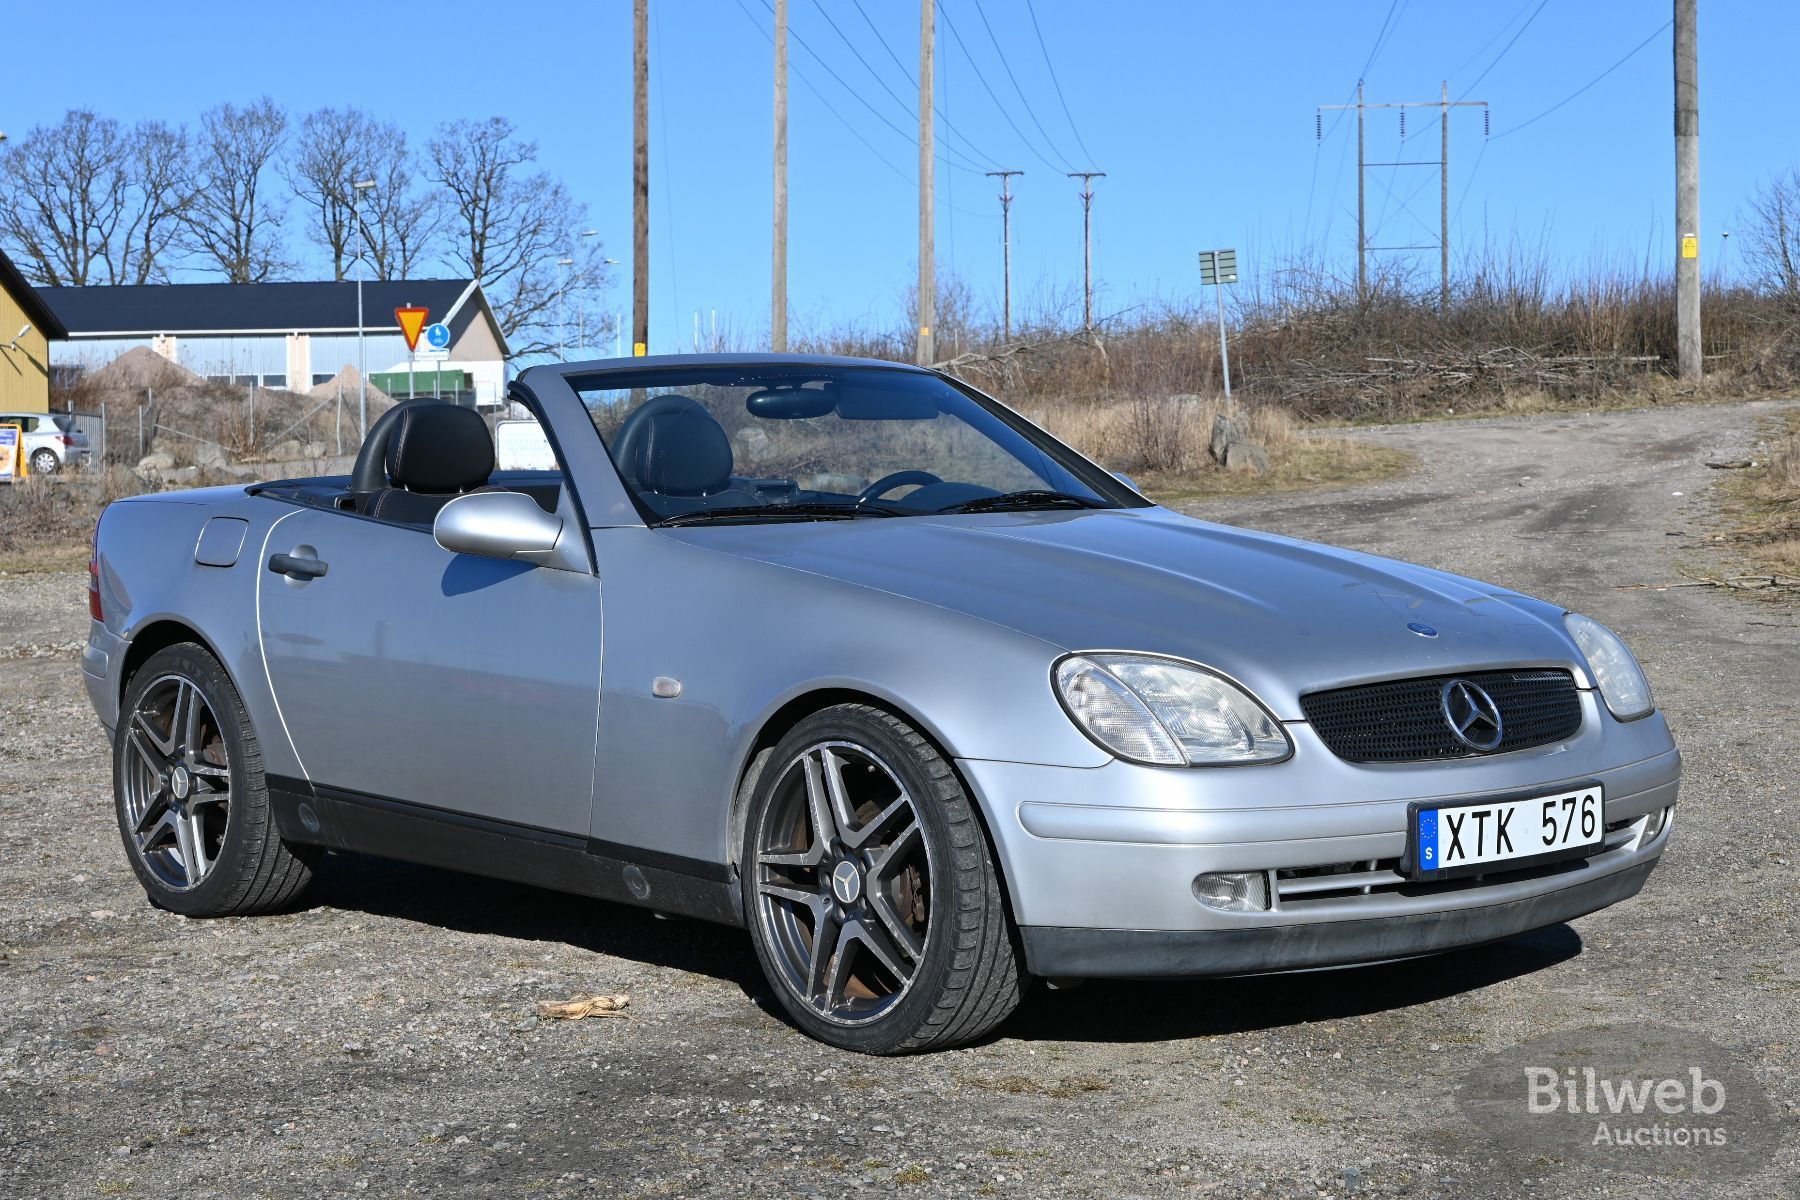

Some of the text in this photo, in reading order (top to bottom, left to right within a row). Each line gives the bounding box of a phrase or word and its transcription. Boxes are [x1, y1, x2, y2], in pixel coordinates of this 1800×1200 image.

[1446, 794, 1596, 861] XTK 576
[1425, 847, 1433, 860] S
